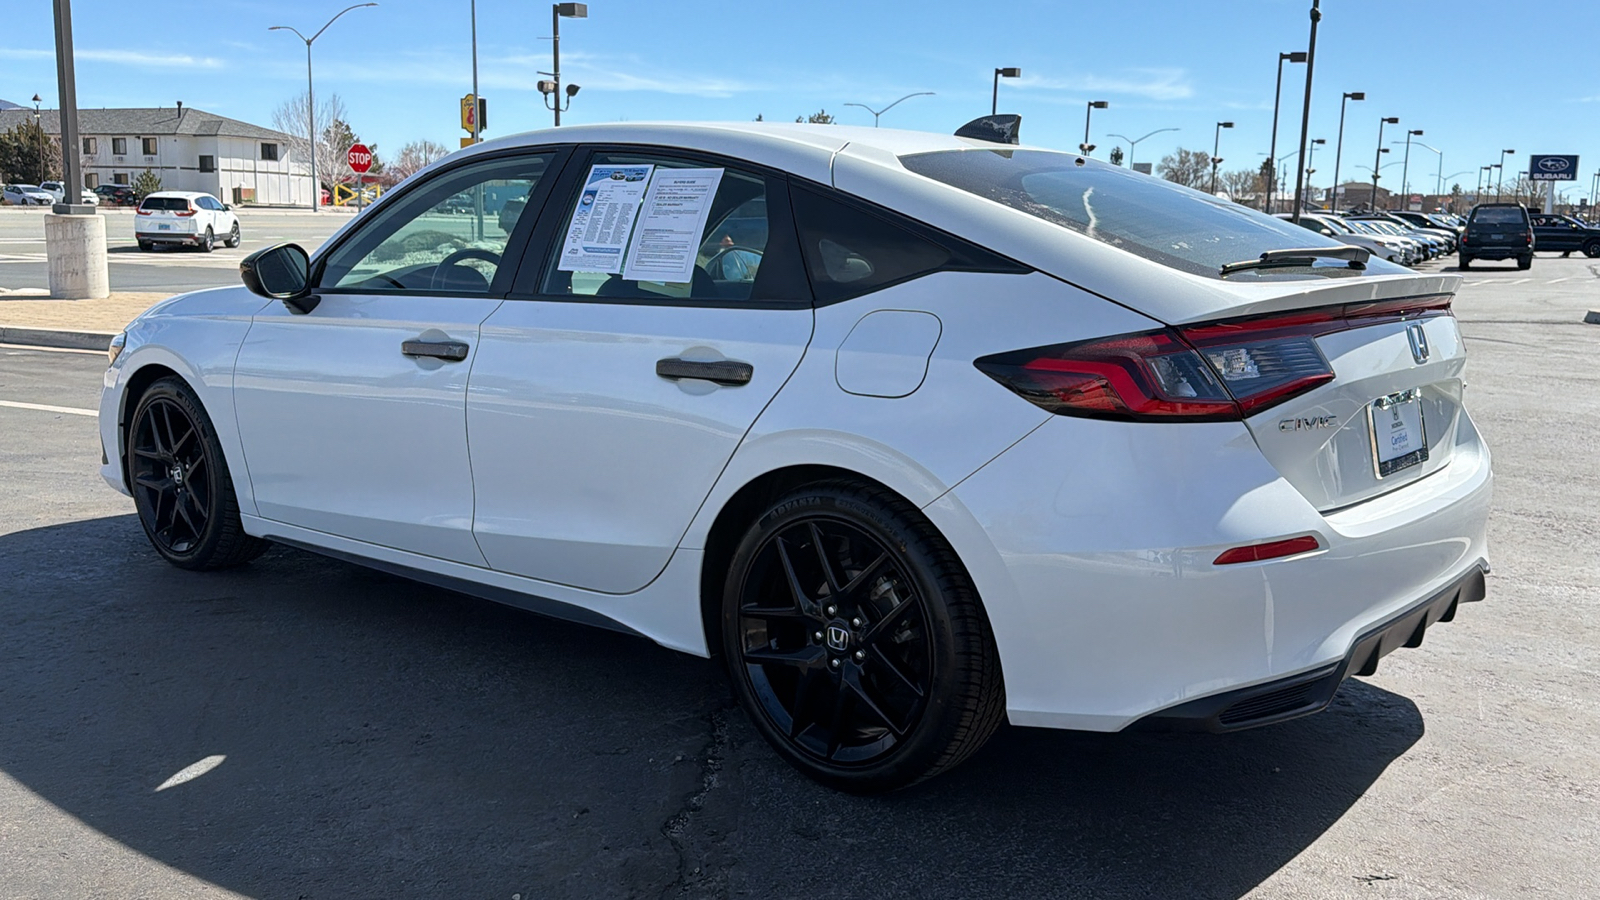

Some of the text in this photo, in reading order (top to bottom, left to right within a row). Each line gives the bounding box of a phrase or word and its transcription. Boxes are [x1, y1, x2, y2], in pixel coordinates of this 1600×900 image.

[349, 152, 371, 165] STOP
[1278, 415, 1337, 432] CIVIC
[1391, 421, 1404, 429] HONDA
[1391, 431, 1408, 446] Certified
[770, 496, 821, 520] ADVANTA
